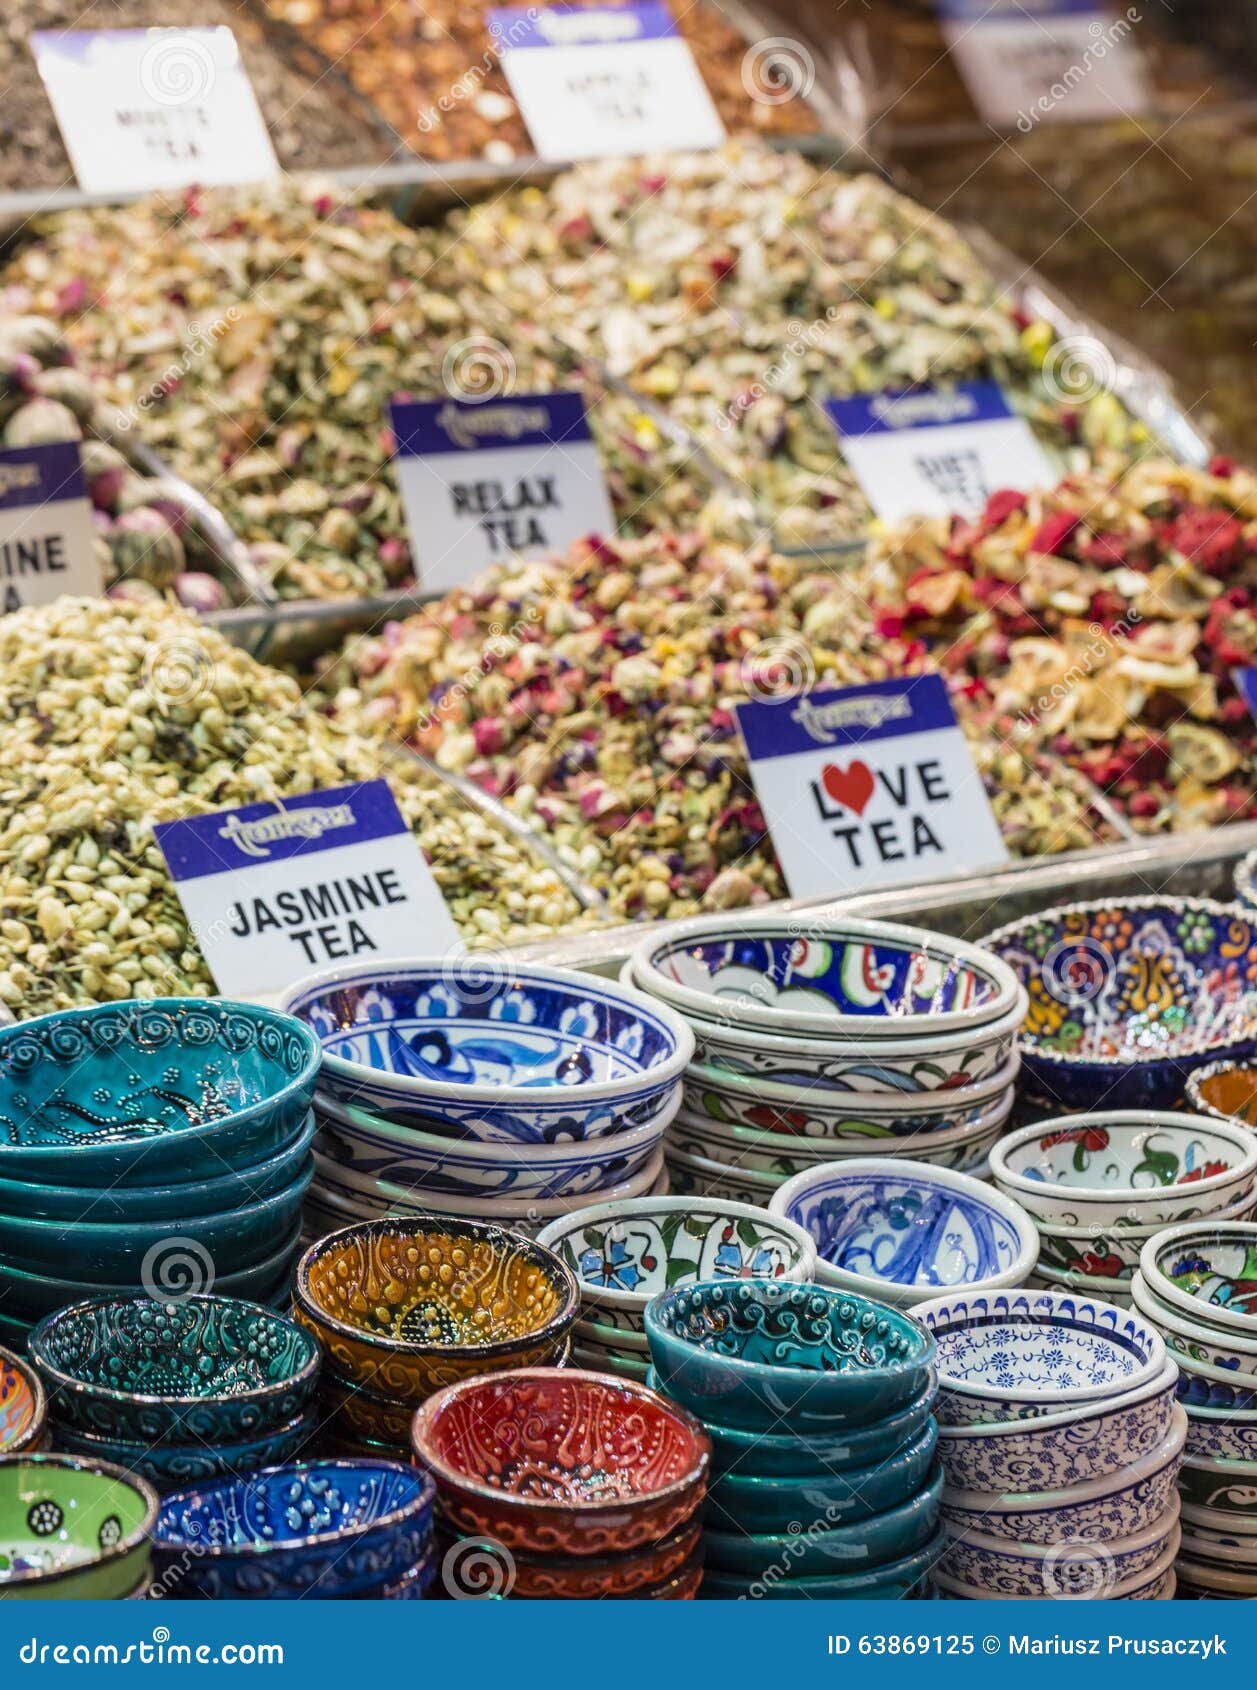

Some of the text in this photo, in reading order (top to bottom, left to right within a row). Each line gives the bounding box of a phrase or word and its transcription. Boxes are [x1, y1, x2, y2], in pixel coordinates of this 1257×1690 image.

[451, 474, 561, 515] RELAX
[481, 516, 548, 552] TEA
[832, 815, 944, 867] TEA
[230, 869, 406, 938] JASMINE
[289, 920, 377, 964] TEA
